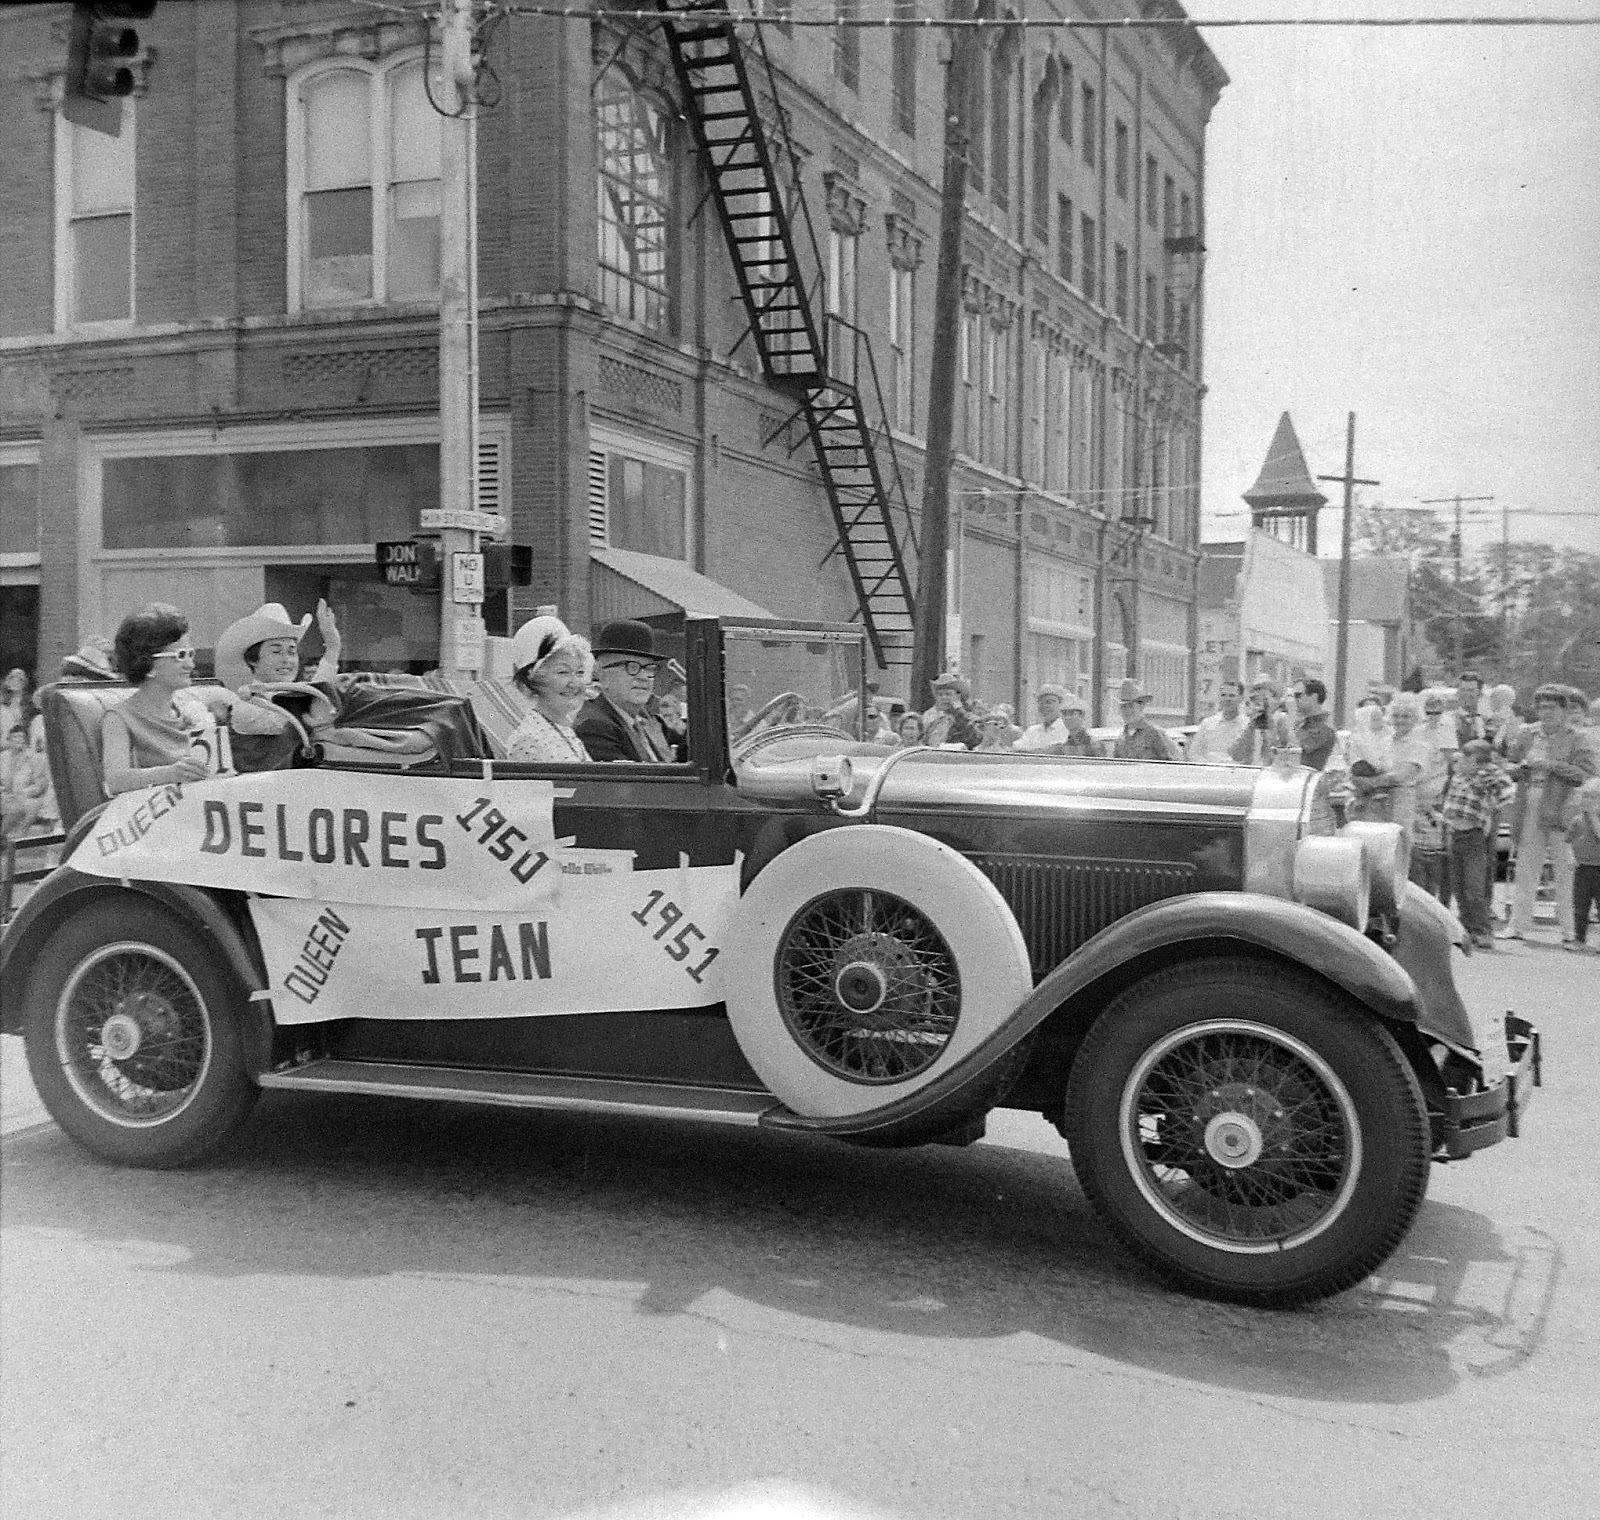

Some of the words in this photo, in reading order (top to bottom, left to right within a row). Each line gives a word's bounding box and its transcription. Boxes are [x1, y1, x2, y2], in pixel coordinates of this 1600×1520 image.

[459, 558, 478, 572] NO
[464, 573, 474, 586] U
[200, 800, 447, 870] DELORES
[456, 797, 549, 884] 1950
[284, 907, 350, 1004] QUEEN
[415, 921, 552, 984] JEAN
[631, 889, 720, 984] 1951
